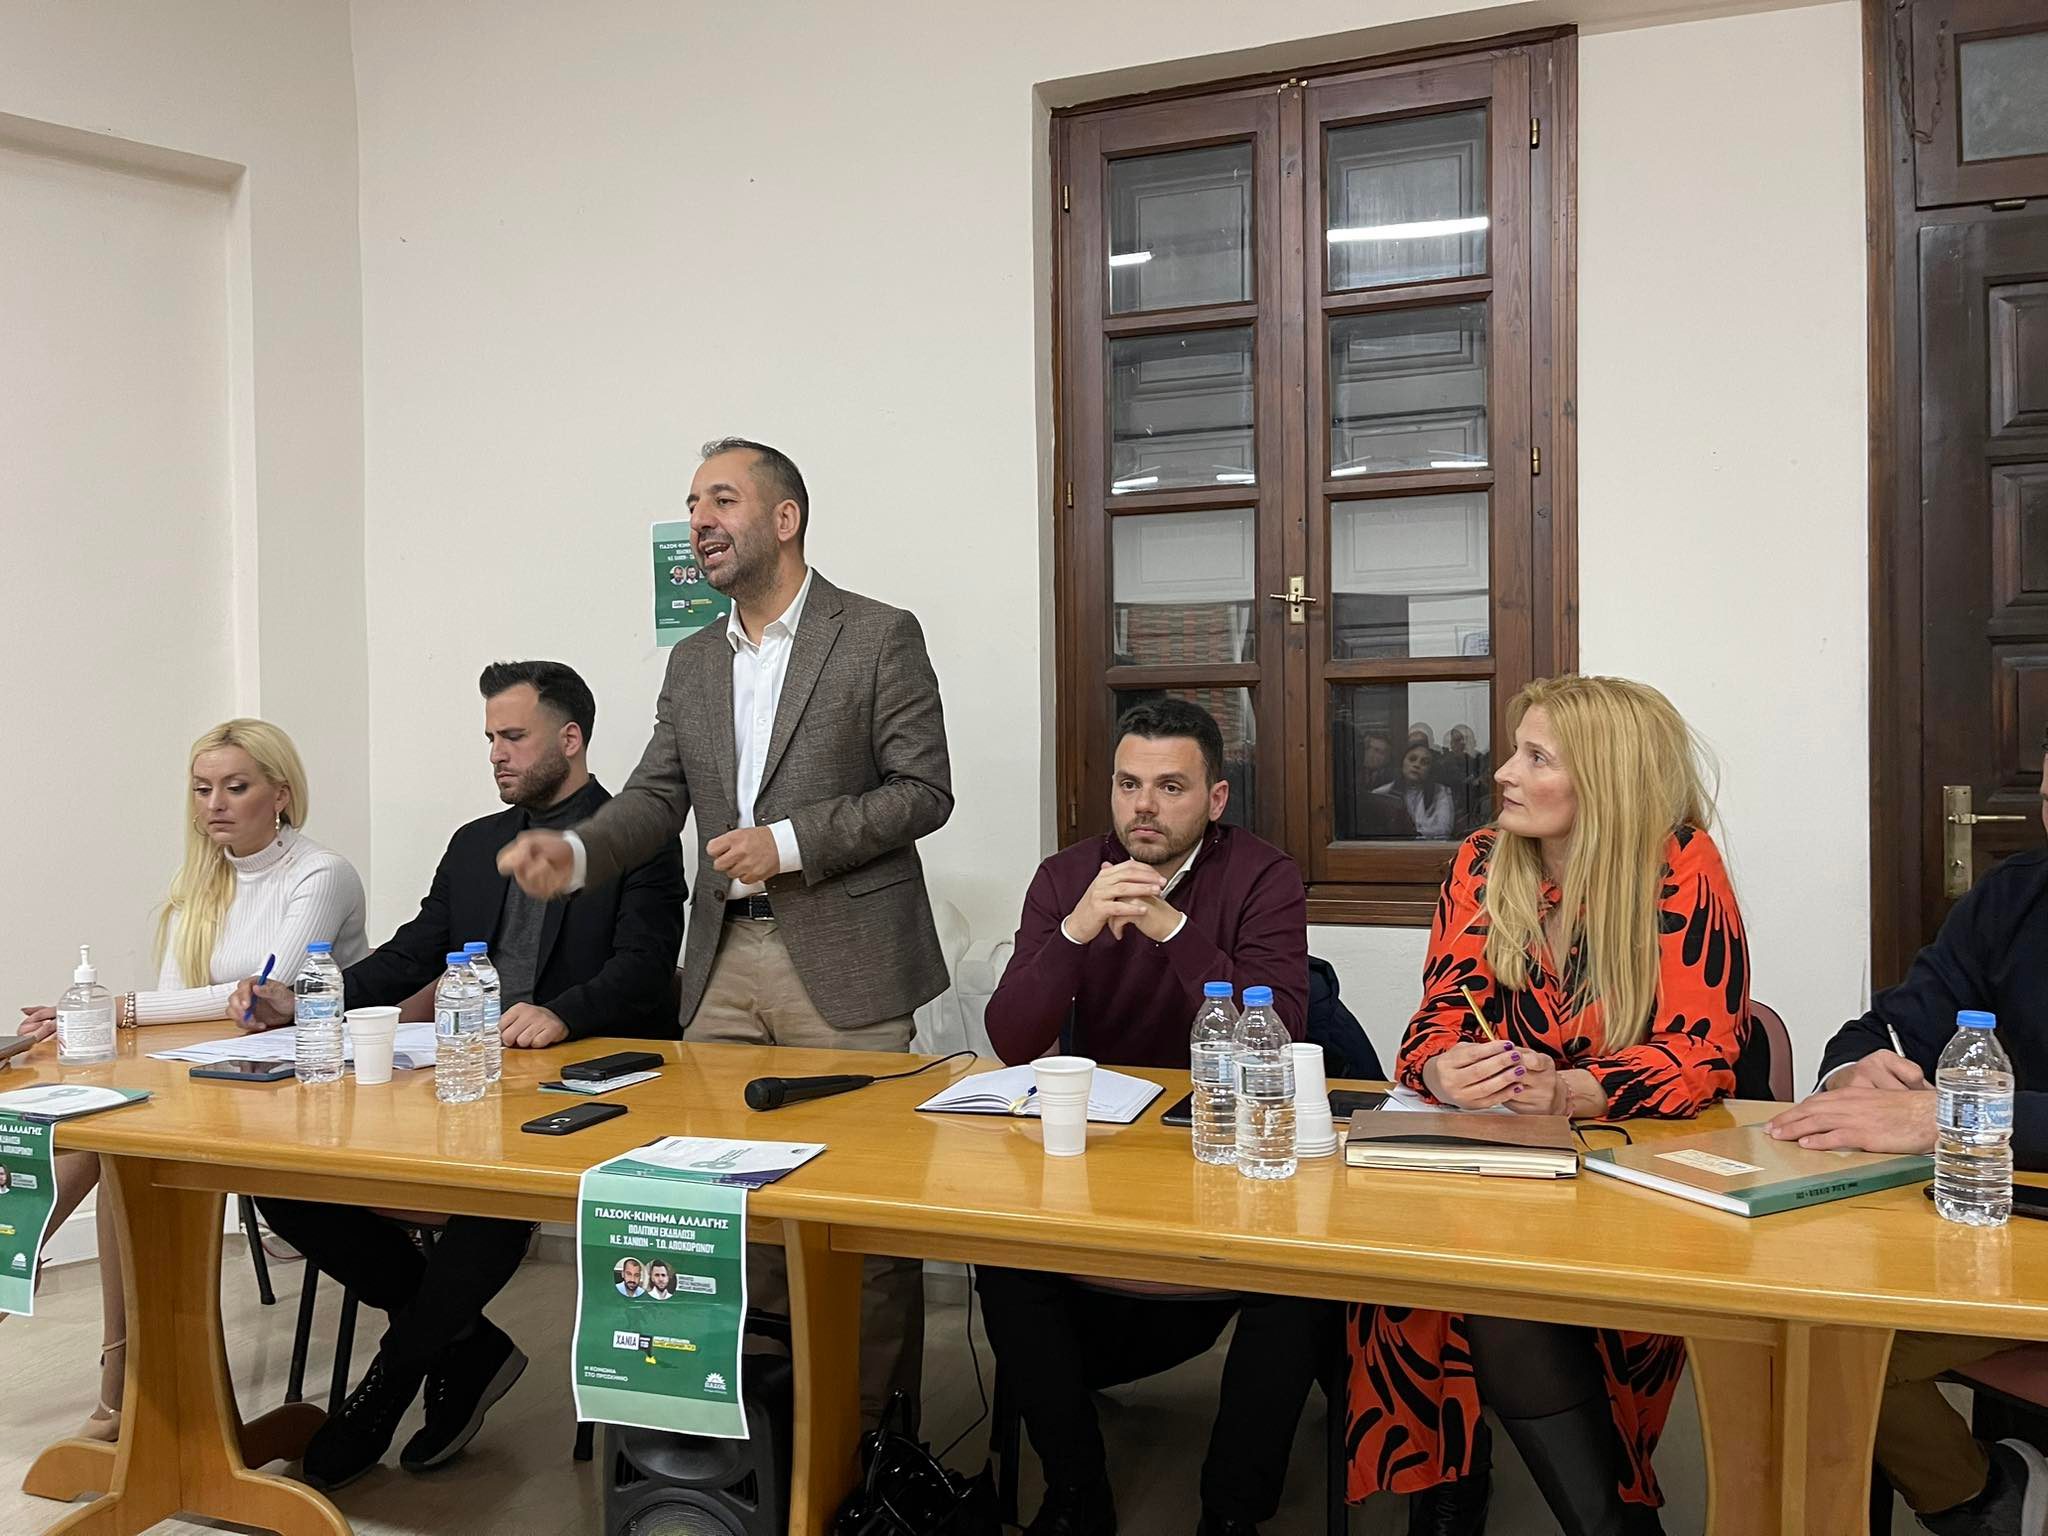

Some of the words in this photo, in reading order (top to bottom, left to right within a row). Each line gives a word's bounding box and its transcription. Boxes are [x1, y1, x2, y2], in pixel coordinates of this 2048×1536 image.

[8, 1125, 43, 1136] ΑΛΛΑΓΗΣ
[595, 1207, 677, 1225] ΠΑΣΟΚ-ΚΙΝΗΜΑ
[678, 1215, 729, 1229] ΑΛΛΑΓΗΣ
[628, 1224, 659, 1237] ΠΟΛΙΤΙΚΗ
[659, 1228, 696, 1240] ΕΚΔΗΛΩΣΗ
[615, 1334, 637, 1347] ΧΑΝΙΑ
